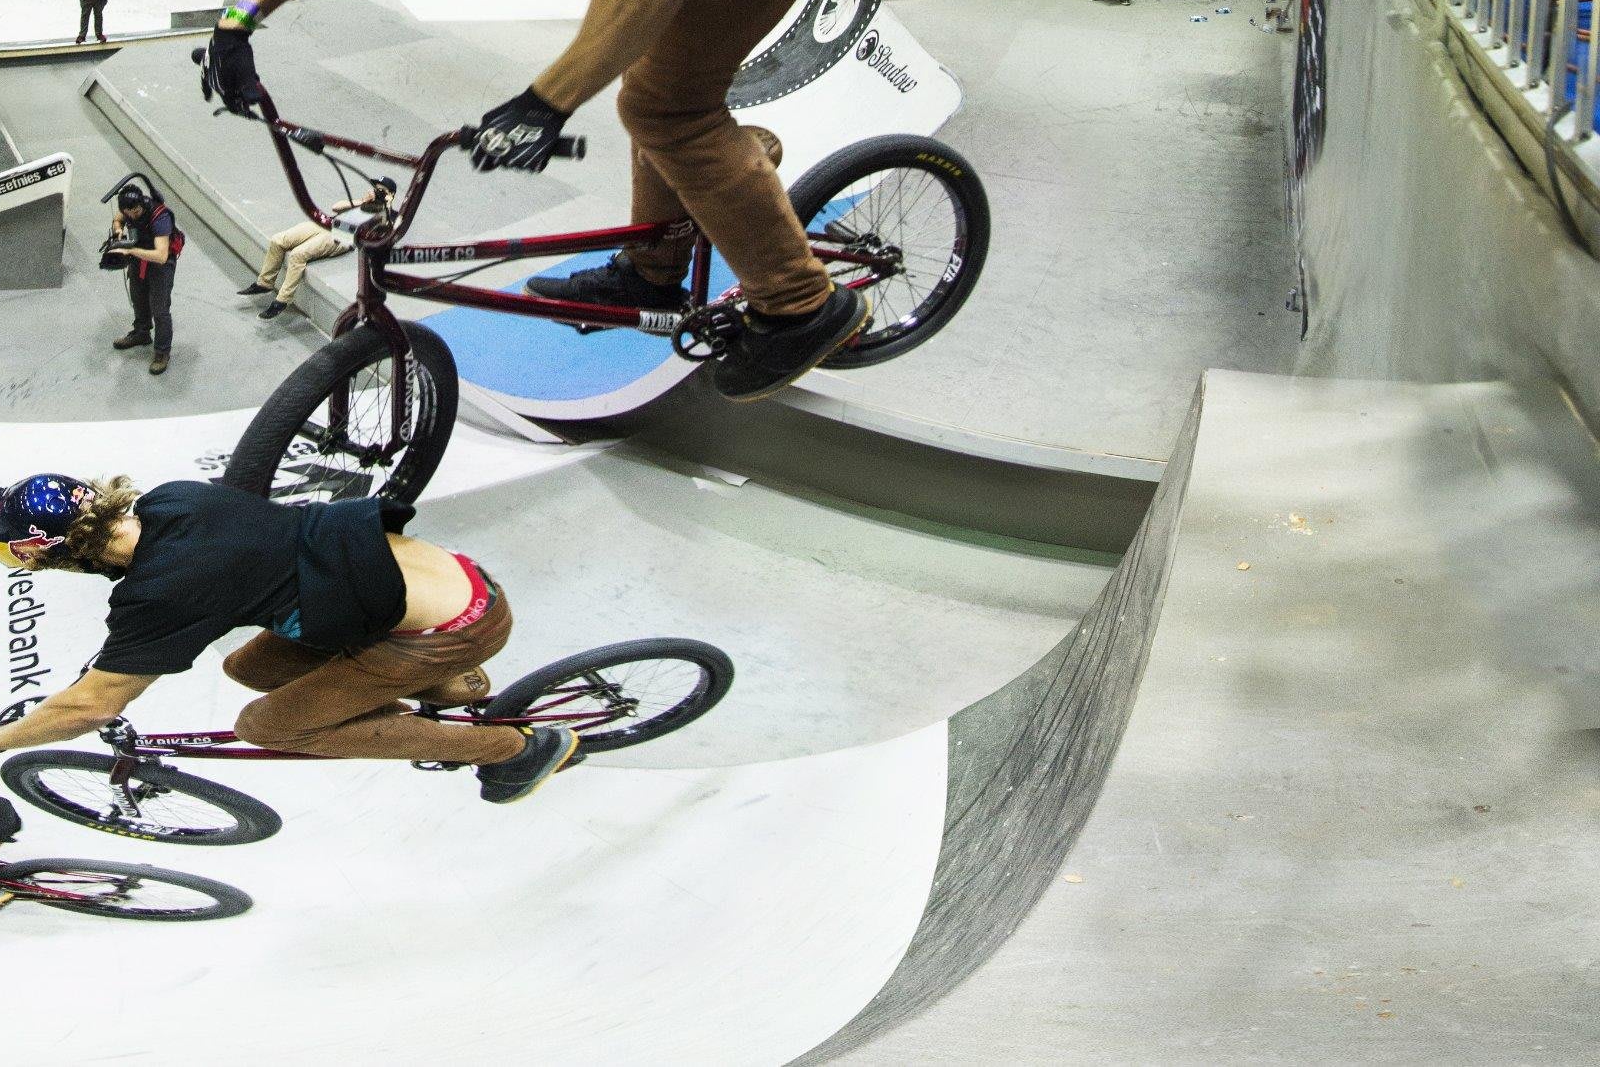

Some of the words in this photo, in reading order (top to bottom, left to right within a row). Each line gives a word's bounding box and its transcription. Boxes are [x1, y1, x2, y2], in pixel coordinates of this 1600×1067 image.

[867, 44, 918, 93] Shadow
[6, 171, 42, 191] etnies
[414, 246, 451, 262] BIKE
[404, 345, 420, 417] TOYOTA
[156, 737, 191, 746] BIKE
